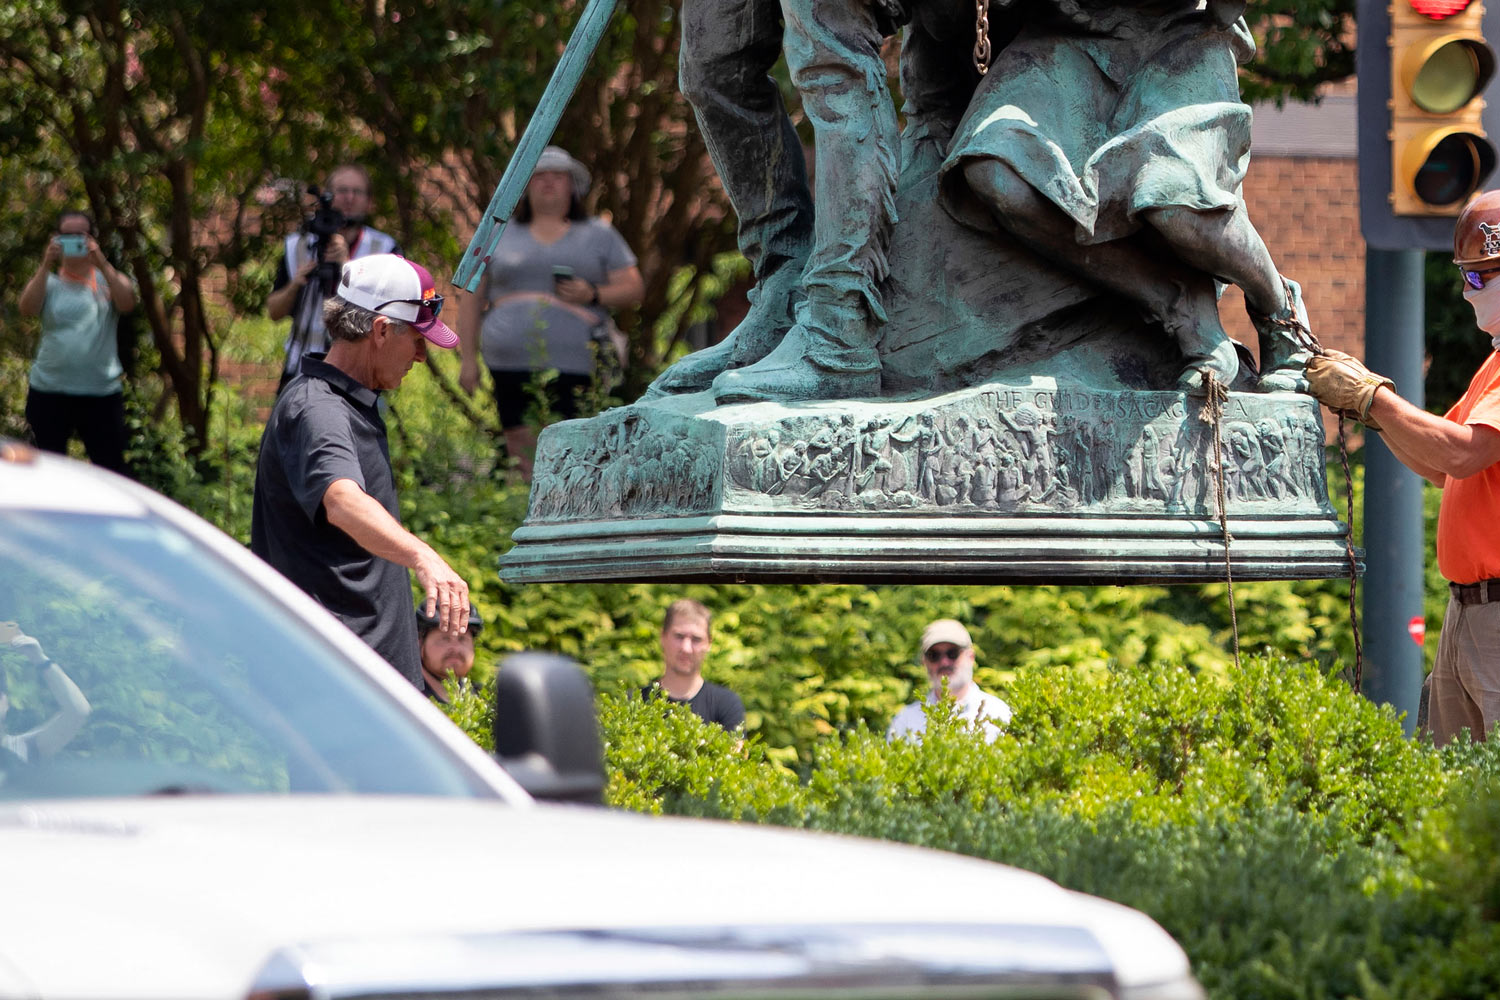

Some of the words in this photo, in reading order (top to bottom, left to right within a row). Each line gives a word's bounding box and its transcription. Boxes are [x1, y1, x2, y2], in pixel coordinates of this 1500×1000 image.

[982, 391, 1022, 409] THE
[1034, 391, 1102, 411] GUIDE
[1115, 398, 1248, 420] SACAGEA
